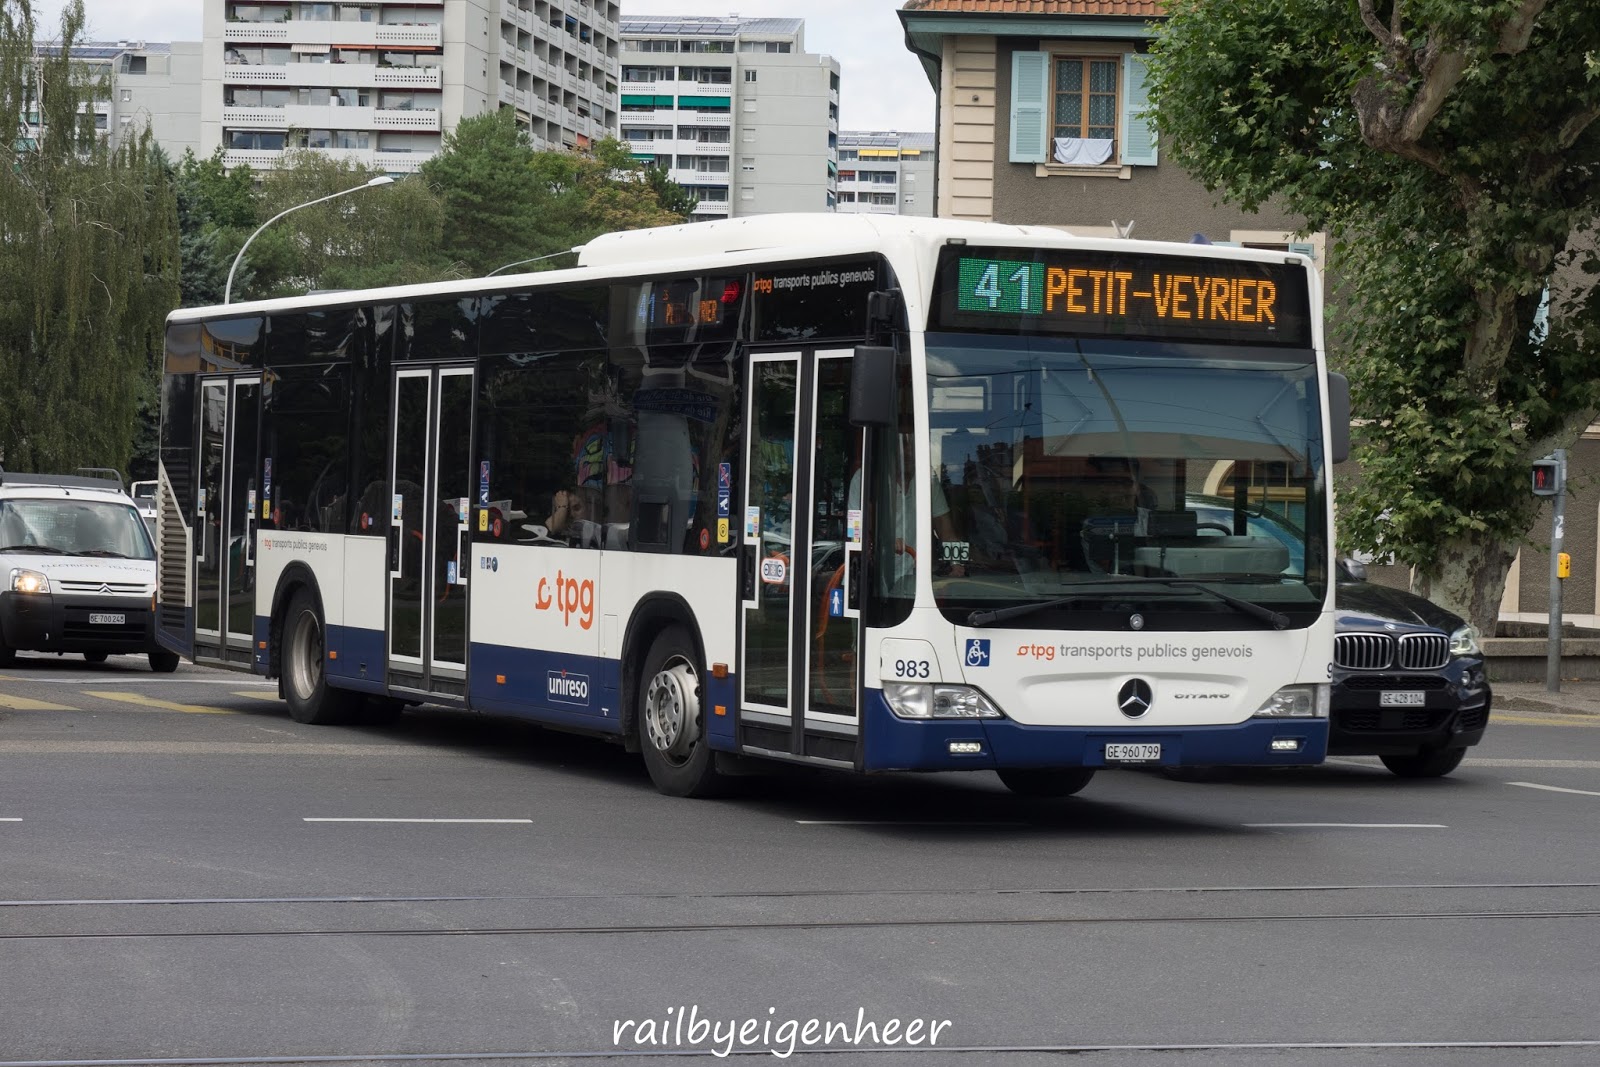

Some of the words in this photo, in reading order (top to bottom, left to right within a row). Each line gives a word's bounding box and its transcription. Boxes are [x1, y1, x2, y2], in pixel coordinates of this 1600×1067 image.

[773, 273, 811, 291] transports
[811, 270, 839, 290] publics
[839, 267, 875, 288] genevois
[974, 263, 1031, 310] 41
[1046, 267, 1276, 323] PETIT-VEYRIER
[272, 539, 293, 550] transports
[293, 539, 308, 552] publics
[308, 541, 328, 553] genevois
[556, 569, 594, 630] tpg
[1060, 643, 1133, 661] transports
[1137, 643, 1187, 661] publics
[1191, 644, 1253, 662] genevois
[895, 659, 930, 679] 983
[548, 669, 588, 698] unireso
